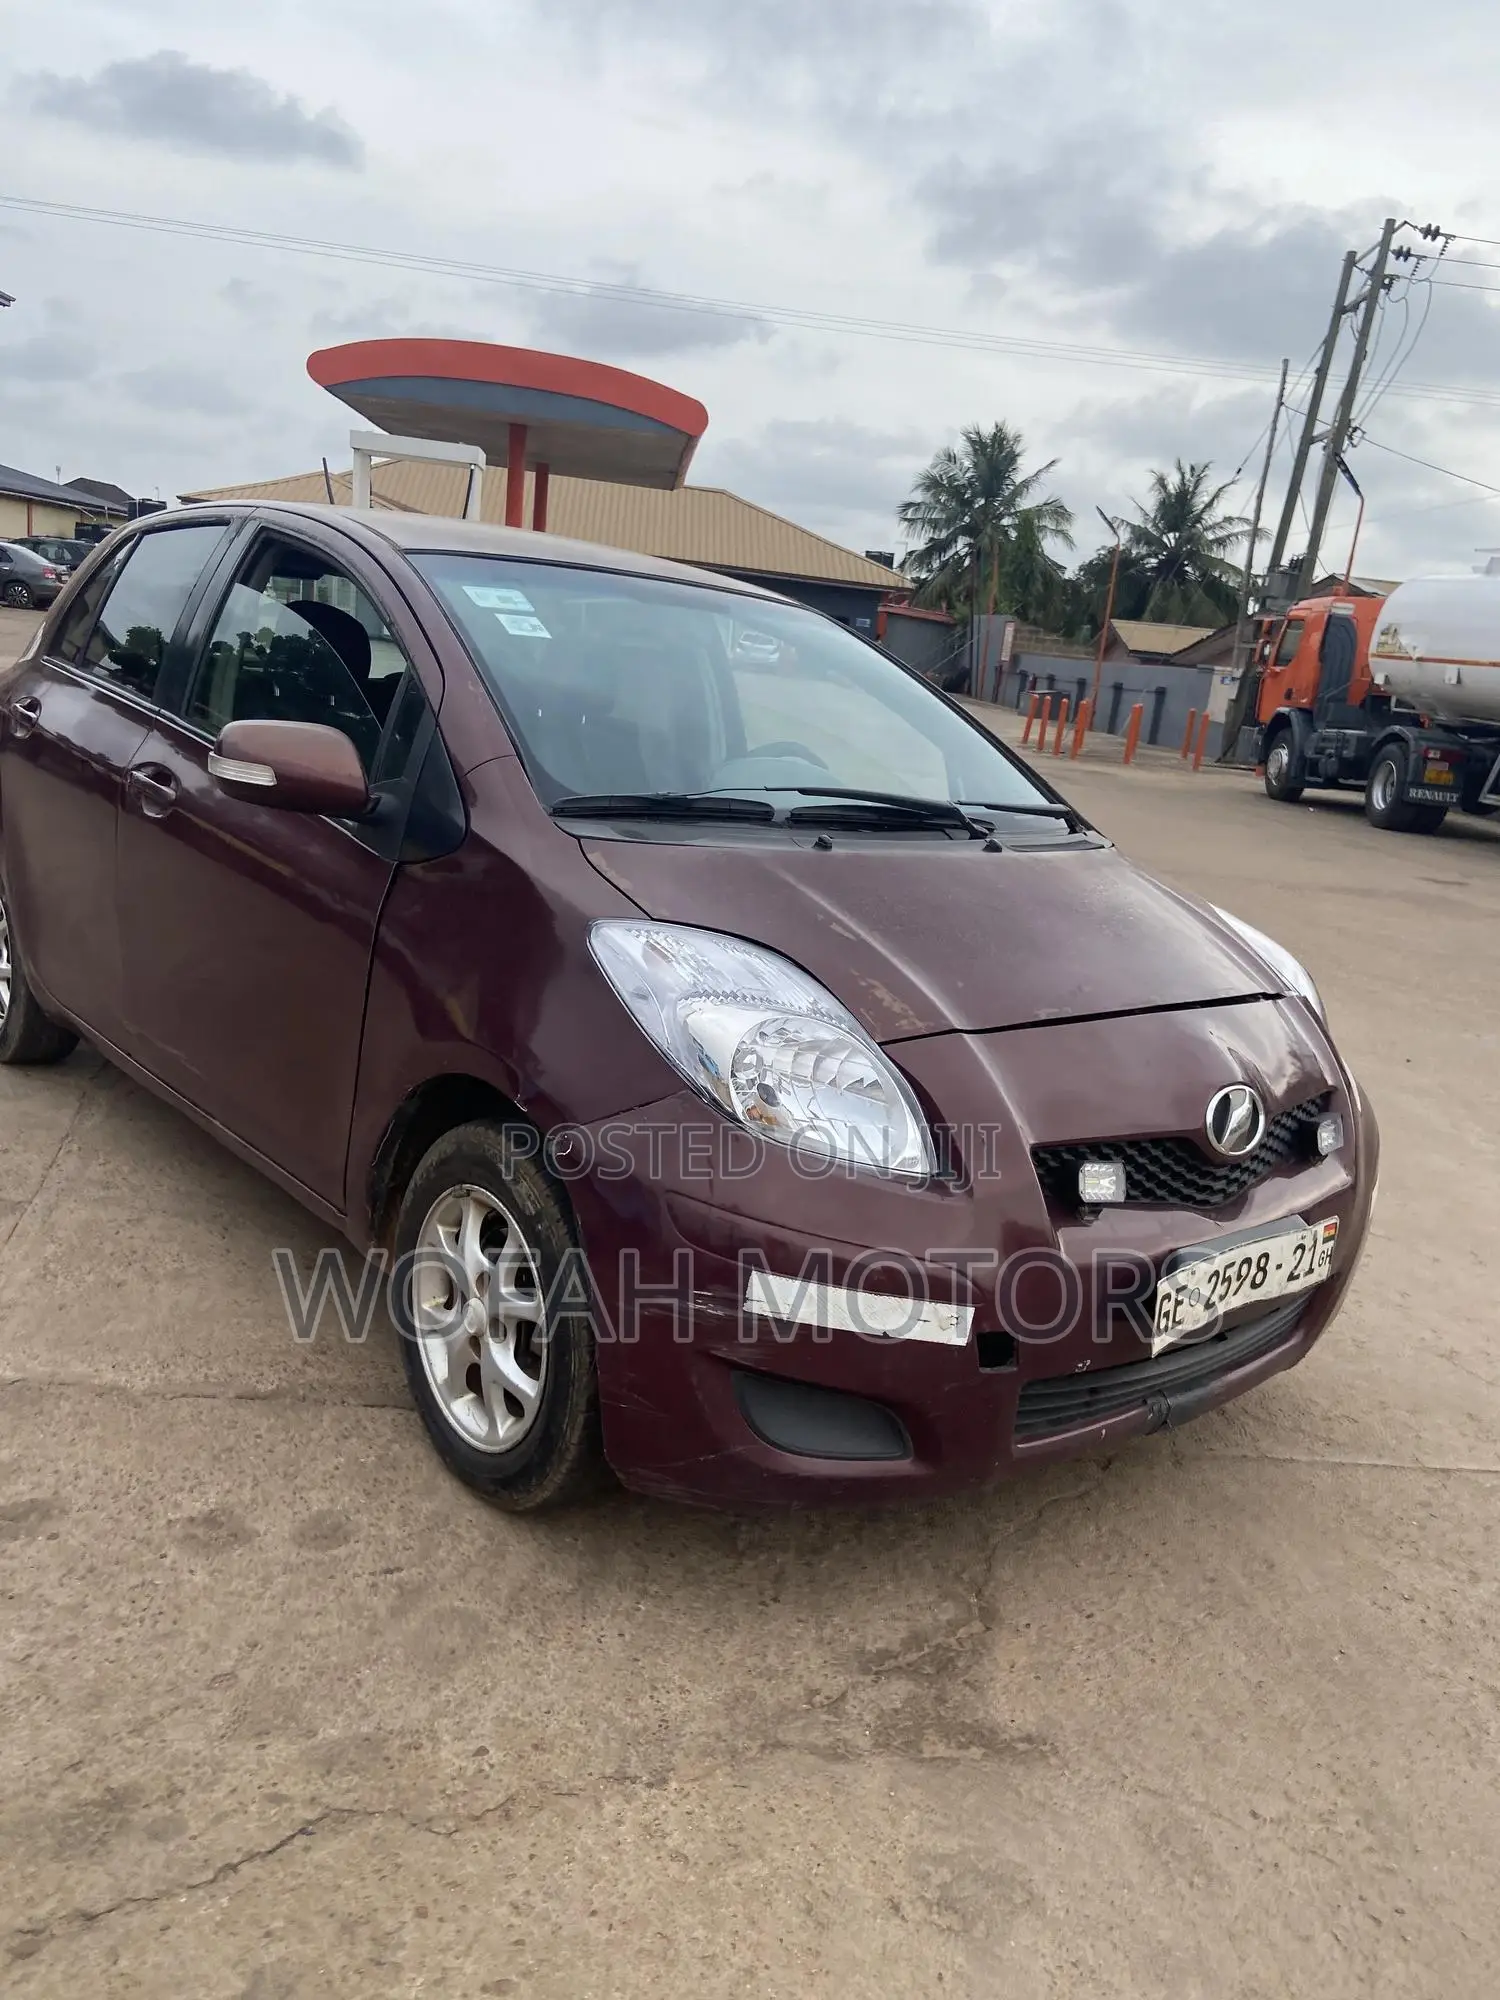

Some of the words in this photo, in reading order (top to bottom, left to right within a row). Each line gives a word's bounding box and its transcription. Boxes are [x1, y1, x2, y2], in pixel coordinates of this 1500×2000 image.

[1409, 788, 1459, 802] RENAULT
[1318, 1246, 1333, 1267] GH
[1156, 1284, 1187, 1334] GE
